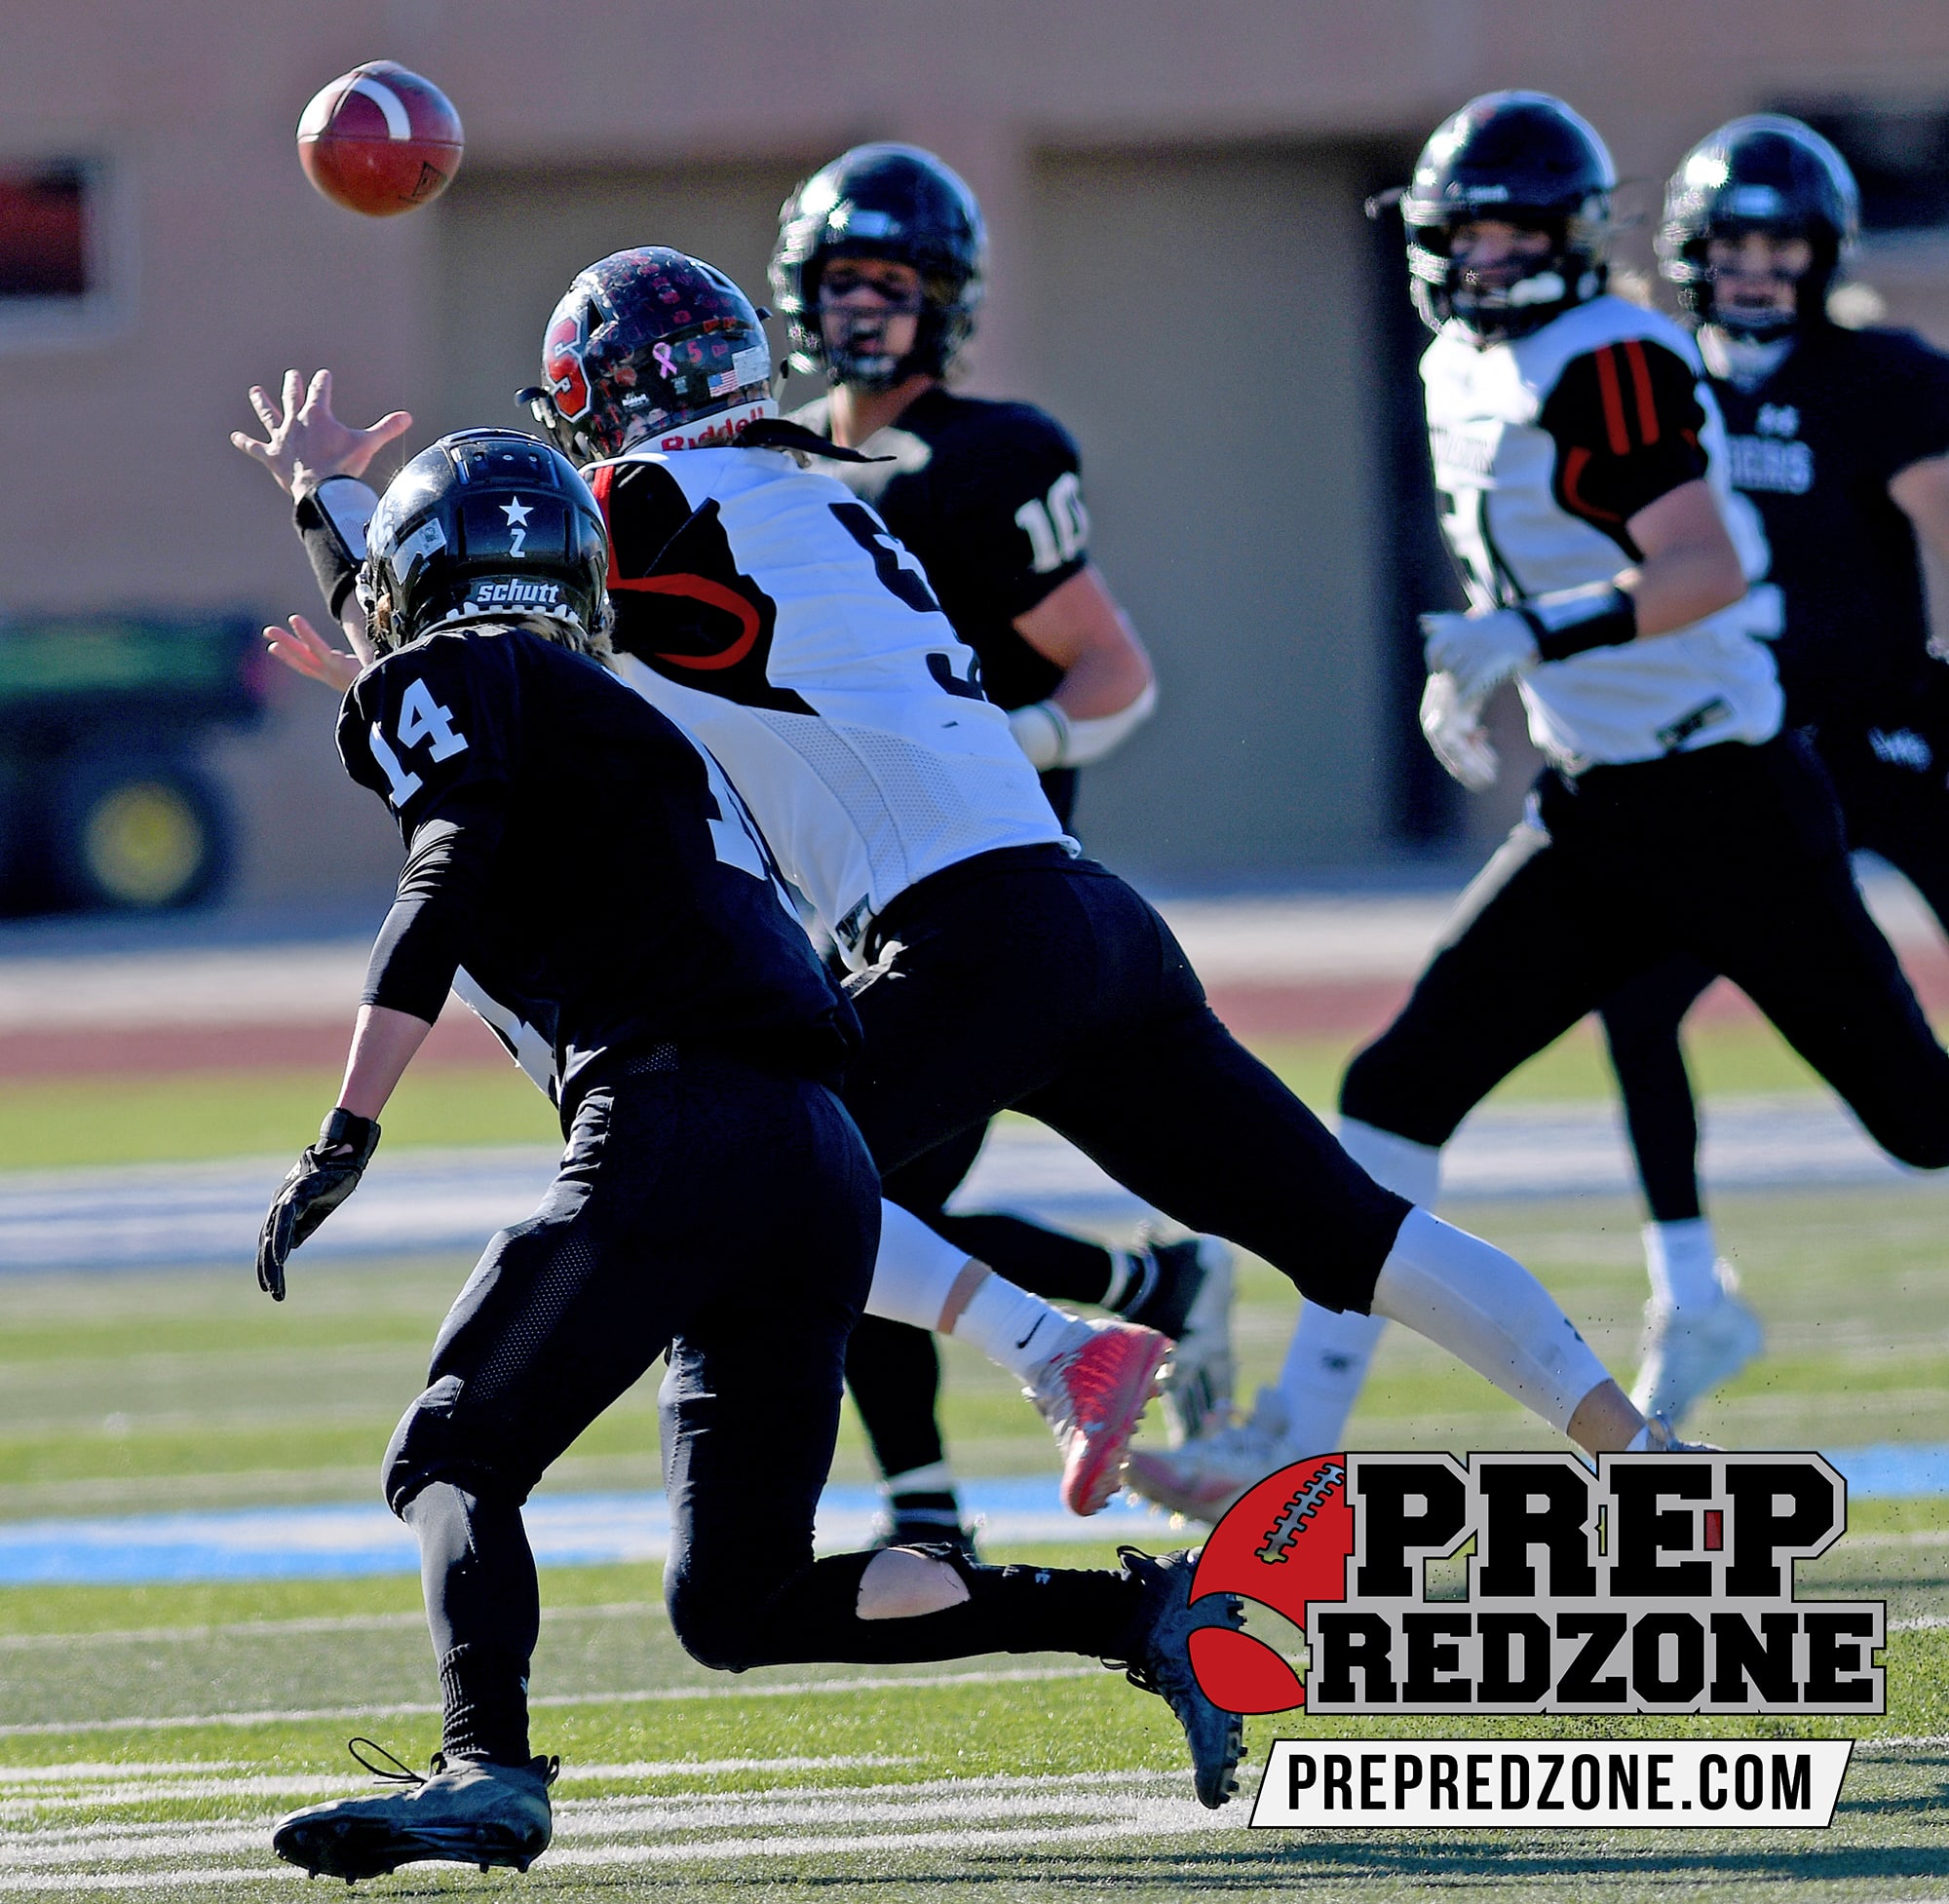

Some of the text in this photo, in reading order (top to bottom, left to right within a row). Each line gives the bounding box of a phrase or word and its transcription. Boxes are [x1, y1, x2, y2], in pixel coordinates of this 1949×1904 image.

[1014, 472, 1089, 575] 10
[477, 578, 559, 605] schutt
[369, 678, 469, 808] 14
